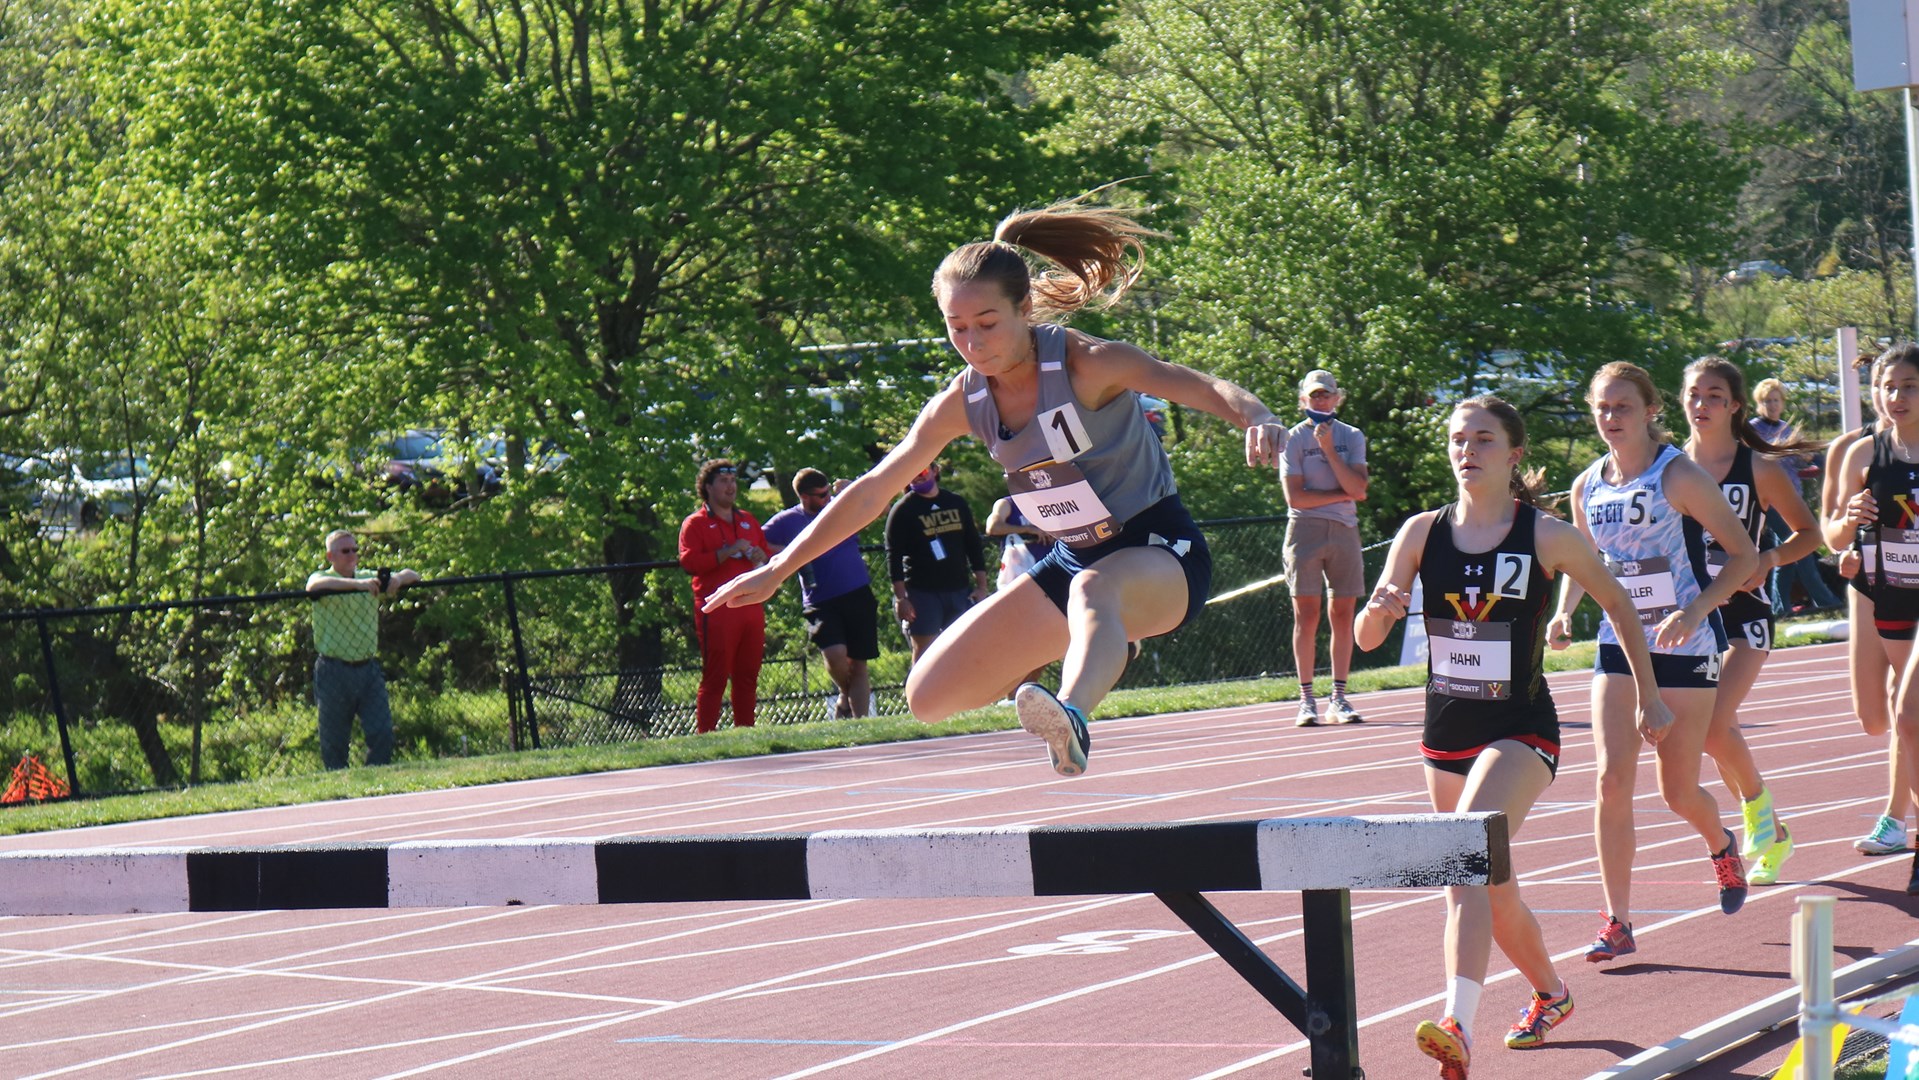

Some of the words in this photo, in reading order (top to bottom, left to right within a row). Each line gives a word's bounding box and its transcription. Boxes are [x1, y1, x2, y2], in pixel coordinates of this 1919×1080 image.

[1051, 410, 1081, 454] 1
[1037, 500, 1080, 518] BROWN
[1629, 491, 1647, 525] 5
[1728, 486, 1744, 516] 9
[1095, 521, 1113, 539] C
[1885, 552, 1919, 564] BELAM
[1501, 556, 1523, 596] 2
[1629, 586, 1653, 598] LLER
[1750, 621, 1766, 649] 9
[1450, 652, 1480, 667] HAHN
